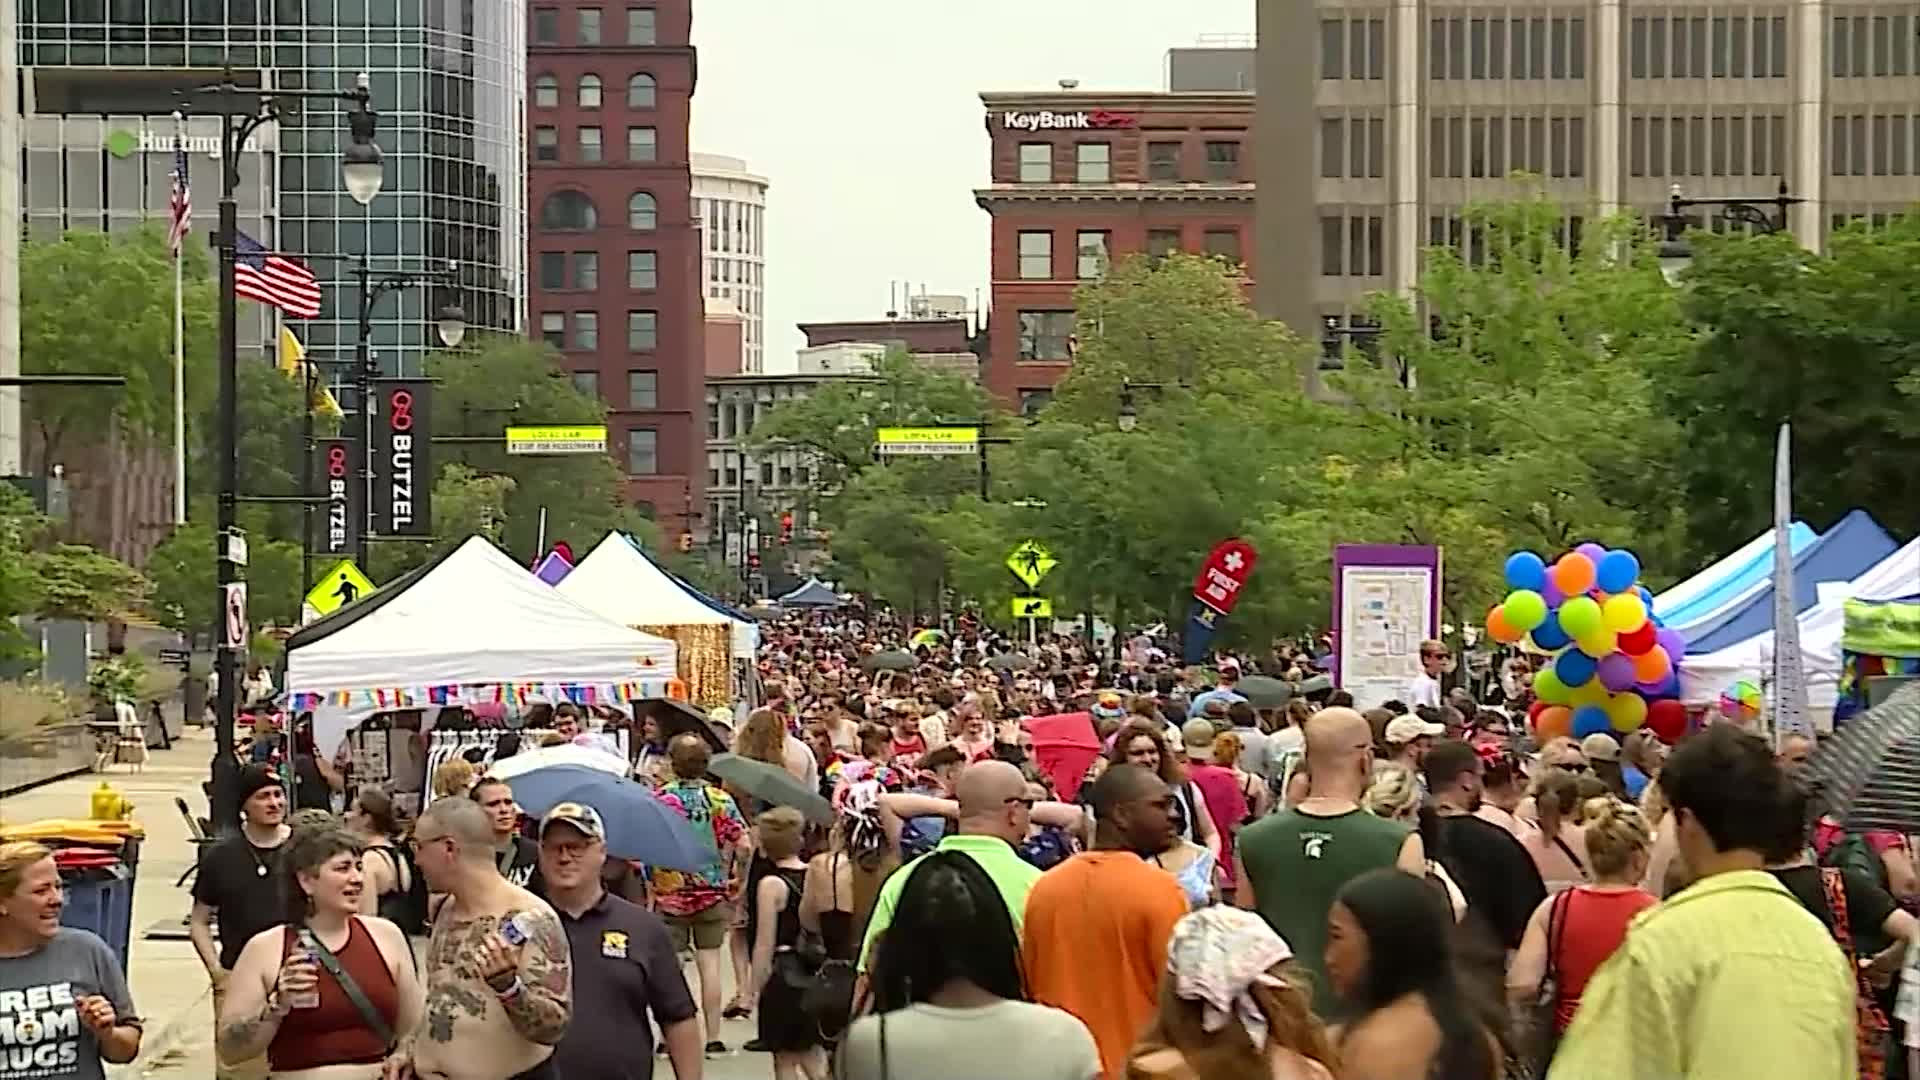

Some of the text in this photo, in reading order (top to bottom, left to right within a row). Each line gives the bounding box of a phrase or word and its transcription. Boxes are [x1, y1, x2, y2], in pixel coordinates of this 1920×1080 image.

[1004, 111, 1091, 131] KeyBank
[392, 434, 412, 531] BUTZEL
[1207, 567, 1241, 593] FIRST
[0, 982, 75, 1013] REE
